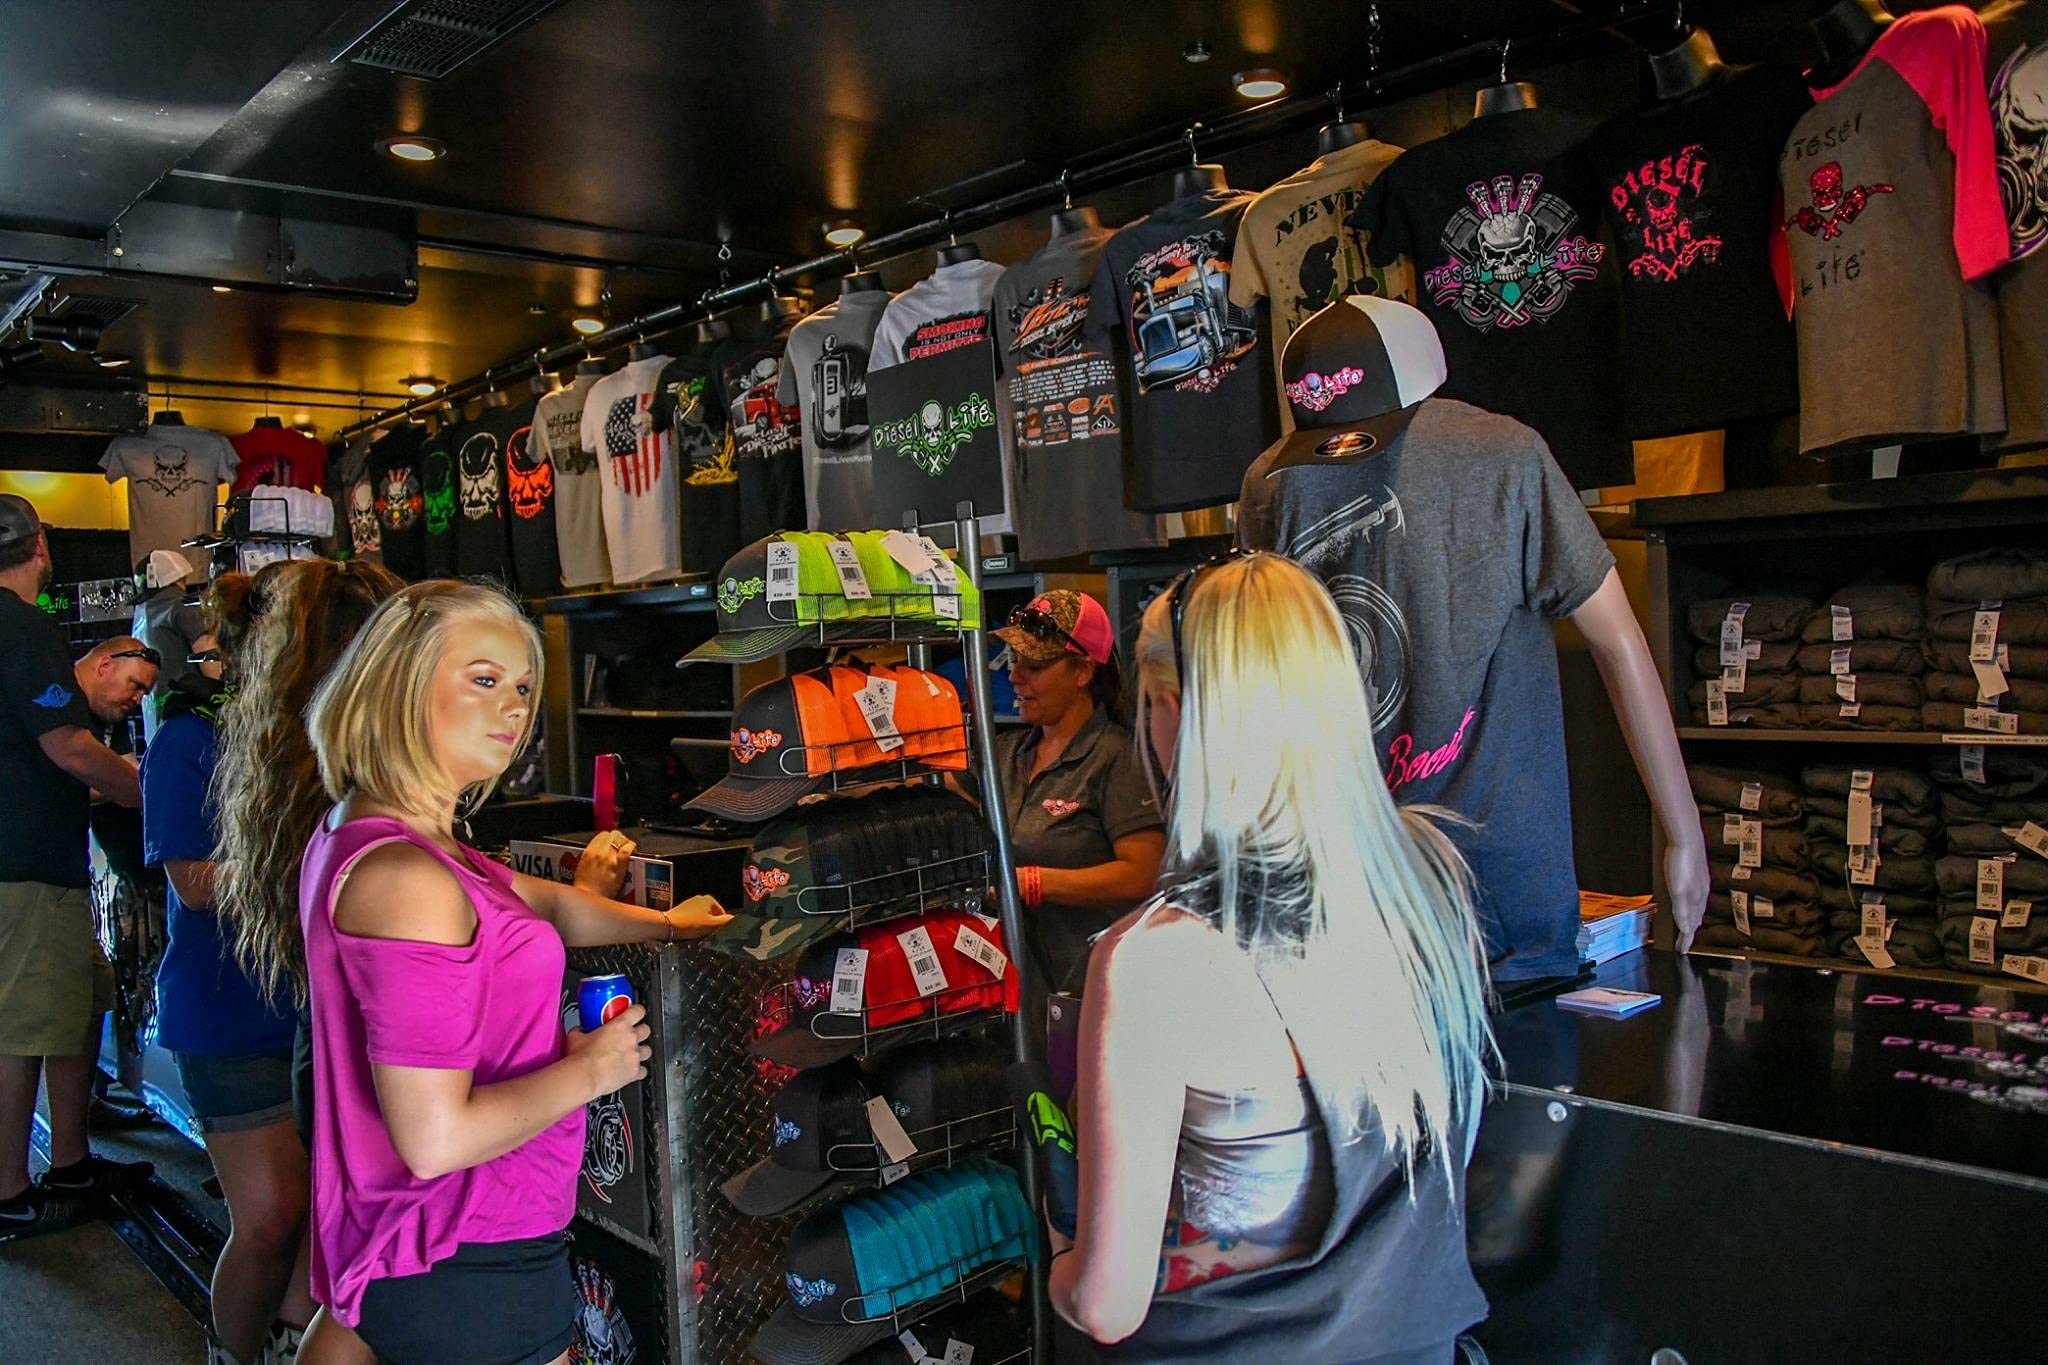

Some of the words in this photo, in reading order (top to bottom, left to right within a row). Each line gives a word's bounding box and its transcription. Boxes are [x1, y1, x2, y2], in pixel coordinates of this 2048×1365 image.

[1274, 190, 1366, 248] NEVE
[1424, 262, 1482, 294] Diesel
[917, 314, 986, 341] SMOKING
[933, 333, 953, 344] NOT
[954, 327, 980, 339] ONLY
[909, 334, 985, 360] PERMITT
[874, 417, 919, 447] Diesel
[948, 396, 990, 430] Life
[514, 853, 554, 881] VISA
[813, 980, 832, 994] Lif
